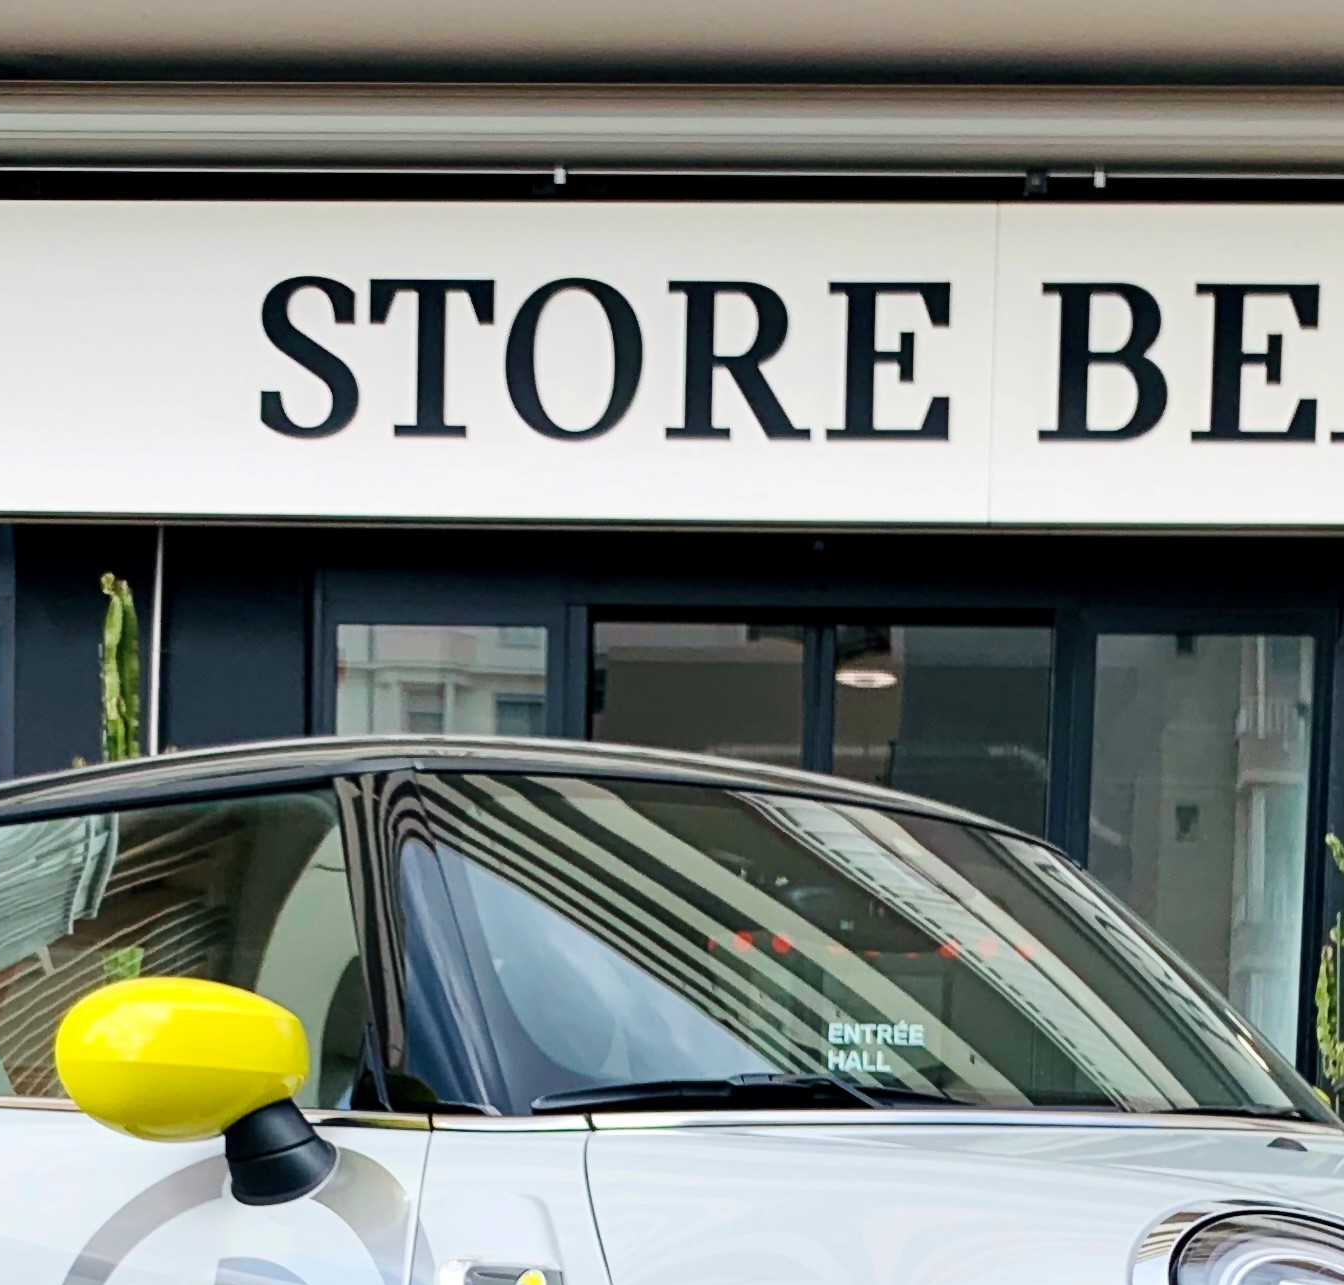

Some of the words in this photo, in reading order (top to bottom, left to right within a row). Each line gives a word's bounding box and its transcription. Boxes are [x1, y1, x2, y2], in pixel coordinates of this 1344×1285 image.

[260, 275, 951, 441] STORE
[828, 1019, 924, 1046] ENTRÉE
[827, 1049, 892, 1072] HALL
